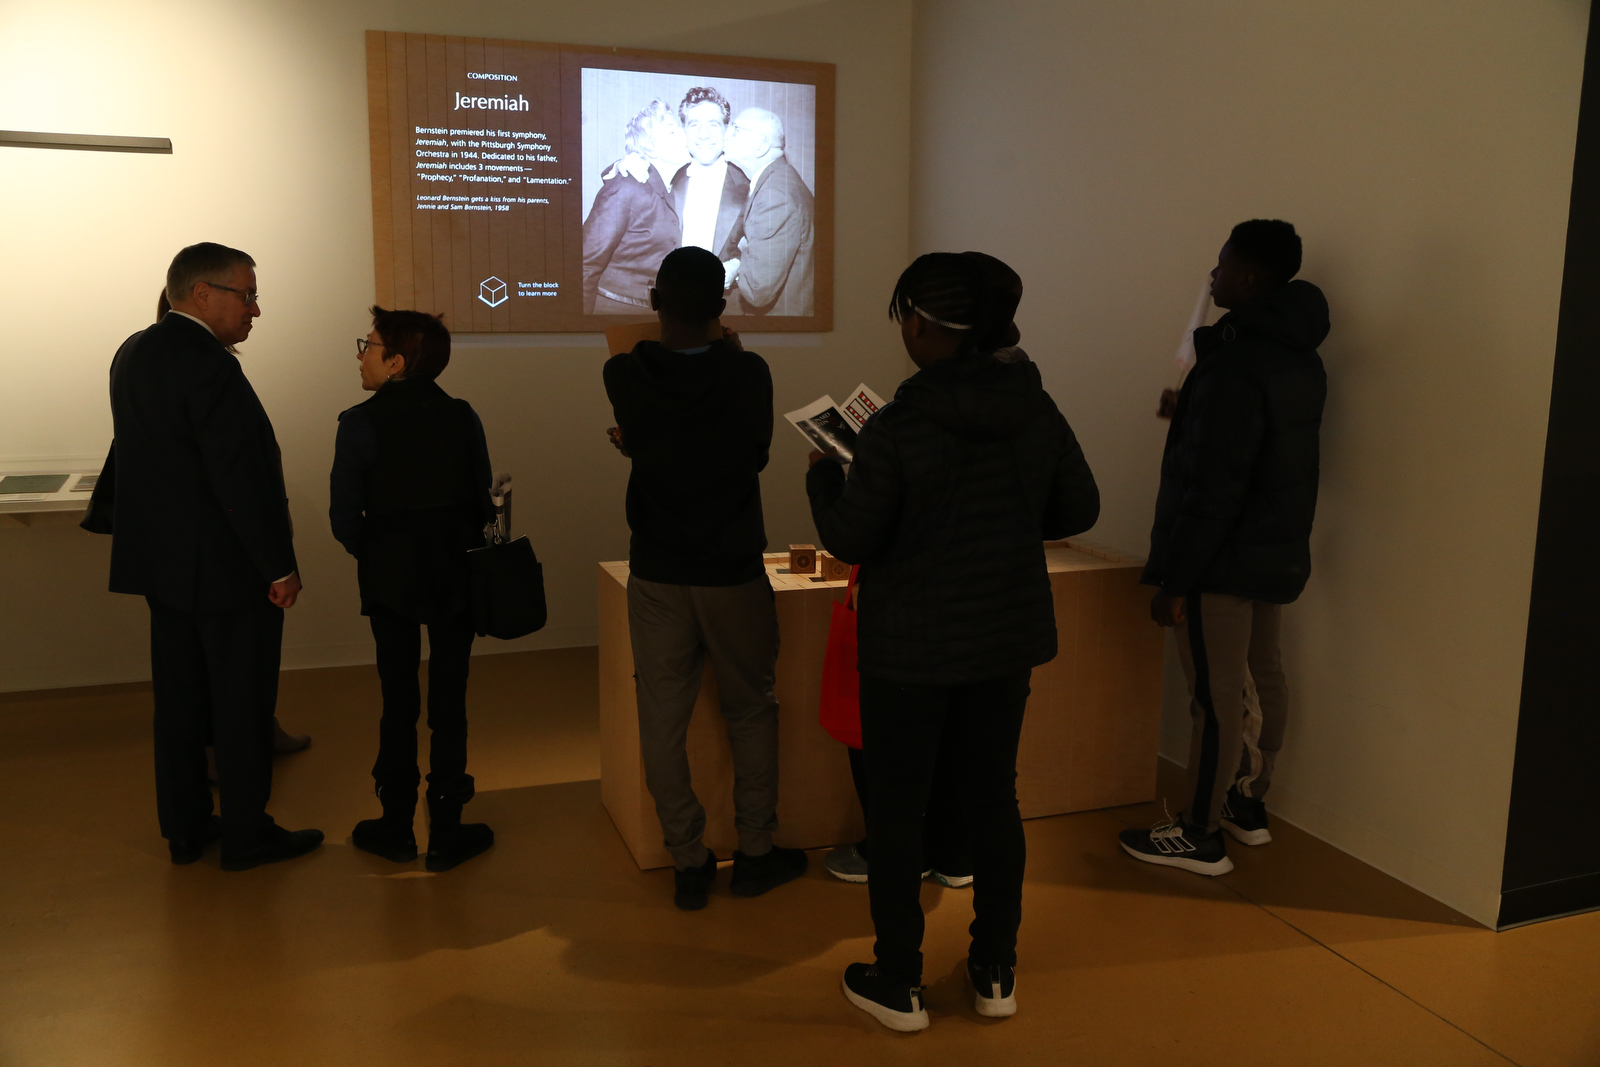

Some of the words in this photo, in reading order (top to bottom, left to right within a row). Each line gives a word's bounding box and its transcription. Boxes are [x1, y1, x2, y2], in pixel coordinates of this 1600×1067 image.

[467, 72, 517, 81] COMPOSITION
[454, 91, 528, 111] Jeremiah
[415, 126, 447, 134] Bernstein
[512, 131, 546, 140] symphony,
[415, 138, 448, 147] Jeremiah,
[481, 140, 515, 150] Pittsburgh
[517, 142, 551, 152] Symphony
[415, 149, 449, 158] Orchestra
[481, 152, 515, 160] Dedicated
[536, 154, 557, 163] father,
[448, 162, 477, 170] includes
